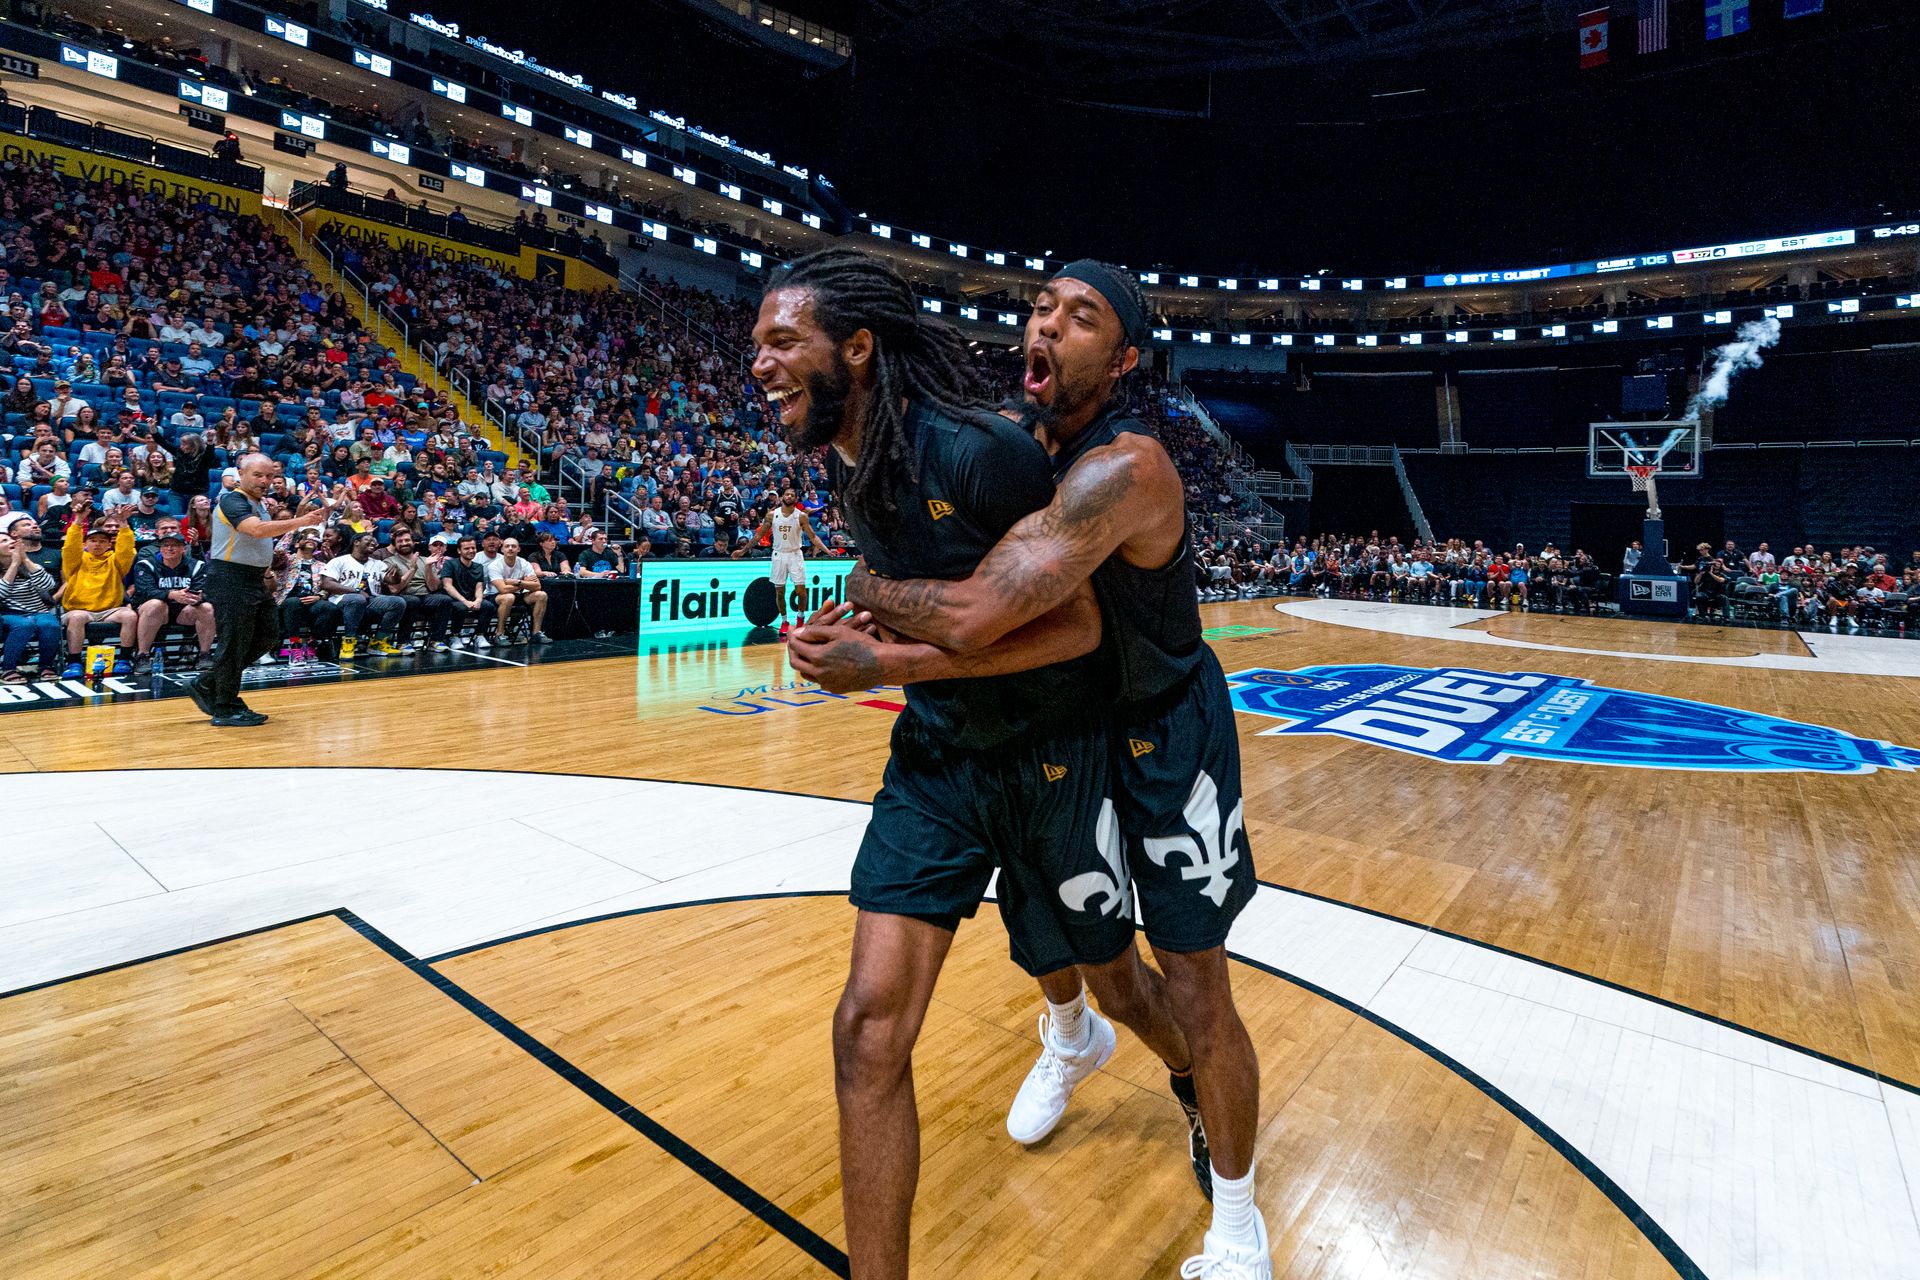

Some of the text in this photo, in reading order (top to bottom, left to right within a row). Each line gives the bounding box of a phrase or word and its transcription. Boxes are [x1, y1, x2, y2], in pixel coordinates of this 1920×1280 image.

[2, 56, 34, 76] 111
[190, 109, 212, 123] 111
[421, 176, 442, 190] 112
[1781, 238, 1808, 247] EST
[649, 575, 848, 621] flair airl
[1313, 671, 1547, 752] DUEL
[1501, 720, 1560, 744] EST
[1537, 689, 1594, 716] OUEST
